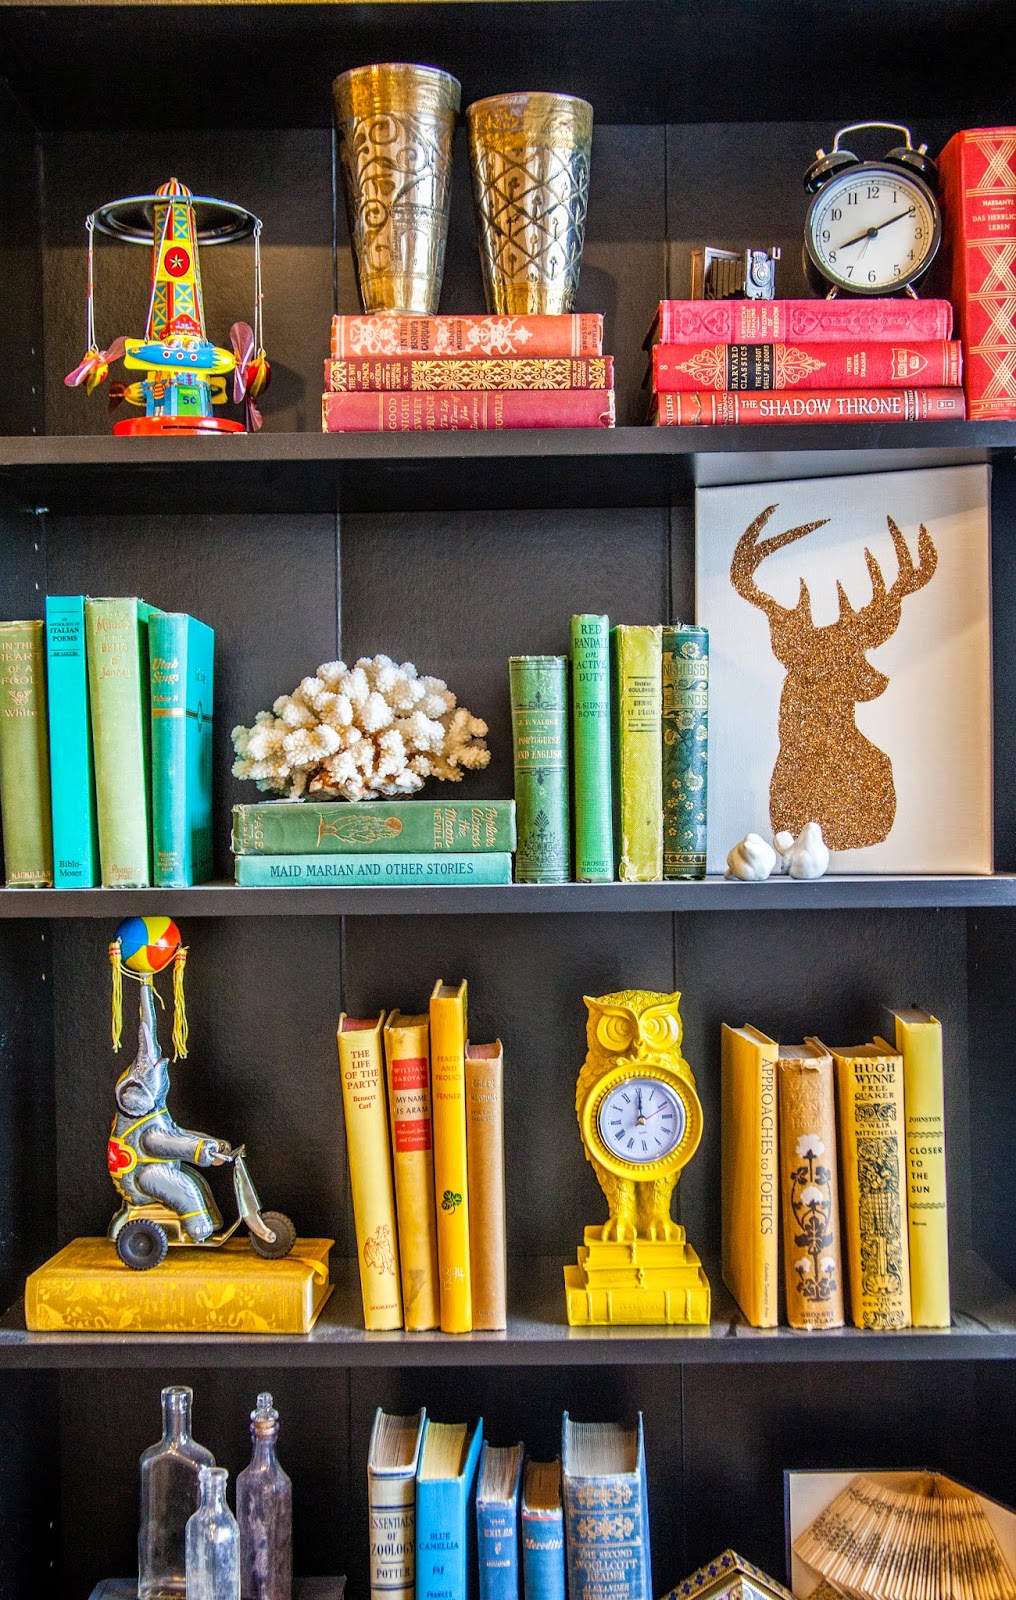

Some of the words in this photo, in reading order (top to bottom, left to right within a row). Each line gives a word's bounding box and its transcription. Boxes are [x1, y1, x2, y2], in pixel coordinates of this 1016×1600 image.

[867, 187, 880, 198] 12
[893, 191, 897, 203] 1
[848, 193, 857, 204] 11
[831, 209, 842, 221] 10
[909, 206, 916, 217] 2
[822, 231, 830, 242] 9
[915, 228, 922, 239] 3
[829, 251, 836, 263] 8
[907, 249, 915, 260] 4
[846, 266, 853, 278] 7
[868, 270, 876, 282] 6
[893, 265, 900, 276] 5
[768, 318, 773, 326] OF
[421, 320, 430, 350] CARRIAGE
[401, 339, 407, 347] IN
[441, 400, 449, 412] Life
[741, 400, 757, 409] THE
[760, 399, 831, 416] SHADOW
[836, 397, 902, 415] THRONE
[389, 398, 397, 429] GOOD
[401, 395, 410, 431] NIGHT,
[414, 397, 422, 429] SWEET
[461, 406, 469, 420] John
[440, 415, 448, 427] The
[581, 624, 602, 634] RED
[2, 642, 12, 650] IN
[101, 643, 128, 652] BELLS
[574, 638, 609, 648] RANDALL
[576, 661, 606, 669] ACTIVE
[2, 676, 38, 685] FOOL
[152, 671, 179, 684] Sings
[579, 673, 605, 682] DUTY
[666, 694, 706, 705] EGENDS
[5, 708, 37, 717] White
[518, 751, 529, 759] AND
[532, 750, 562, 758] ENGLISH
[255, 813, 264, 849] PAGE
[434, 808, 442, 848] NEVILLE
[445, 808, 457, 847] Moon
[459, 819, 470, 837] the
[472, 808, 483, 847] Across
[482, 808, 499, 847] Poplars
[270, 865, 302, 877] MAID
[306, 864, 353, 876] MARIAN
[357, 864, 380, 875] AND
[386, 863, 423, 875] OTHER
[427, 863, 473, 874] STORIES
[351, 1050, 370, 1058] THE
[854, 1064, 895, 1072] HUGH
[360, 1070, 379, 1078] THE
[855, 1075, 895, 1083] WYNNE
[347, 1079, 379, 1090] PARTY
[473, 1080, 495, 1088] GREEN
[359, 1102, 371, 1110] Cerf
[406, 1106, 428, 1114] ARAM
[761, 1057, 774, 1156] APPROACHES
[910, 1147, 943, 1155] CLOSER
[761, 1158, 769, 1170] to
[760, 1173, 773, 1235] POETICS
[430, 1532, 450, 1540] BLUE
[372, 1544, 414, 1556] ZOOLOGY
[580, 1550, 596, 1558] THE
[600, 1549, 632, 1557] SECOND
[576, 1559, 638, 1569] WOOLLCOTT
[376, 1568, 410, 1578] POTTER
[587, 1571, 625, 1581] READER
